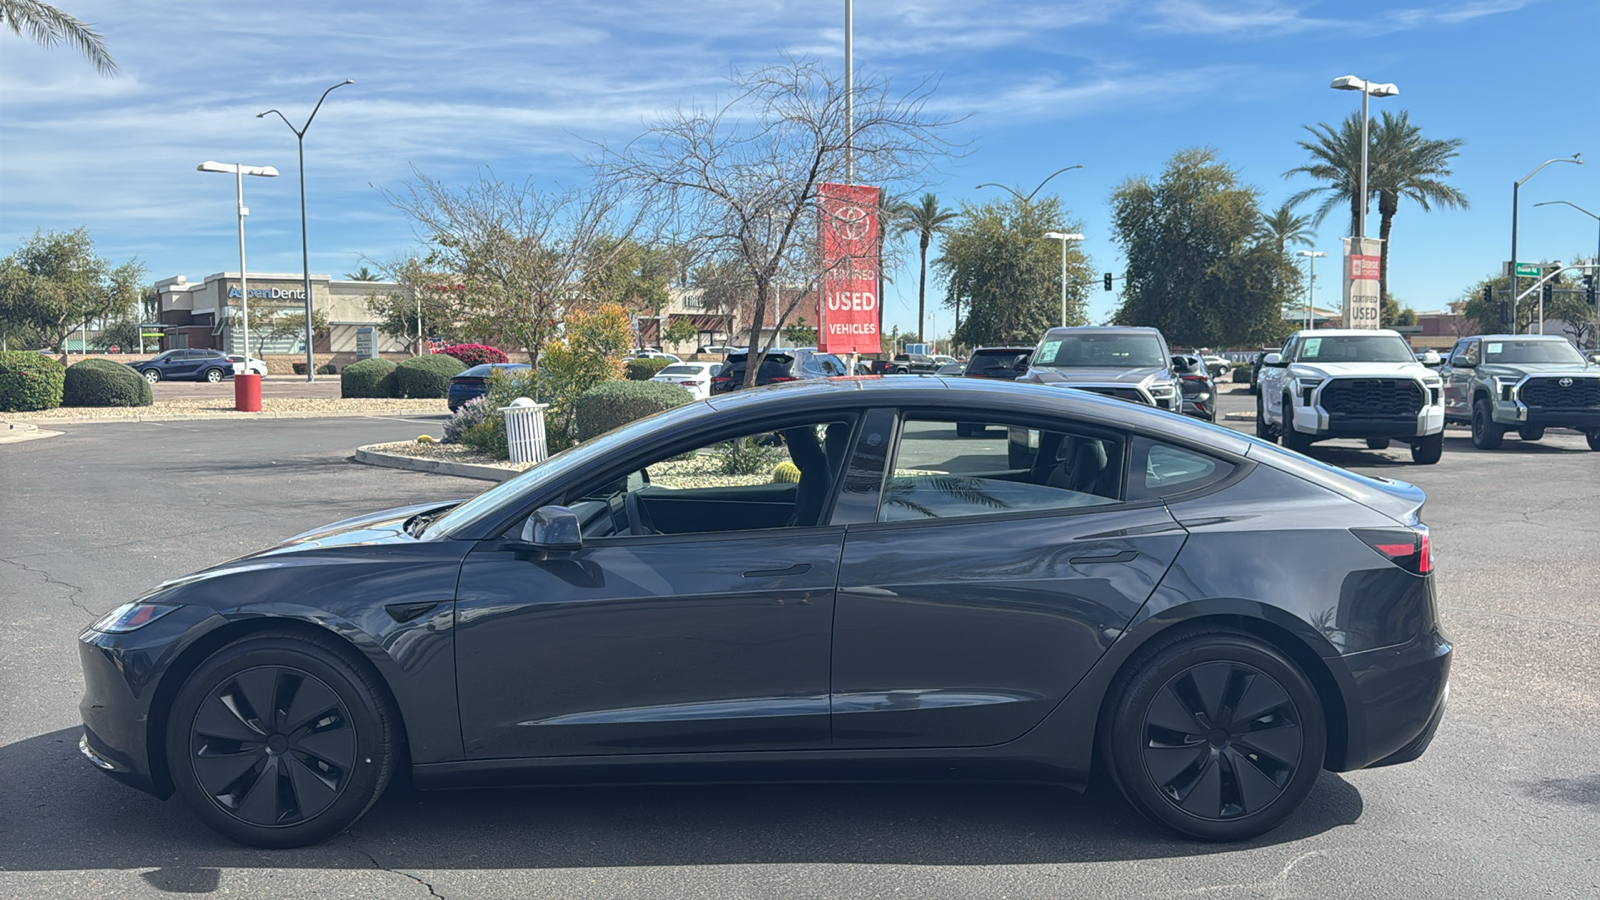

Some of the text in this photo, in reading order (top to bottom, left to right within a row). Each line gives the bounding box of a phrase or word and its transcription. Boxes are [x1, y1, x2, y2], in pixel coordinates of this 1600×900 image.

[827, 269, 875, 281] CERFIED
[229, 284, 306, 299] AspenDenta
[828, 292, 875, 311] USED
[1352, 295, 1378, 303] CERTIFIED
[1352, 307, 1378, 320] USED
[829, 323, 876, 334] VEHICLES
